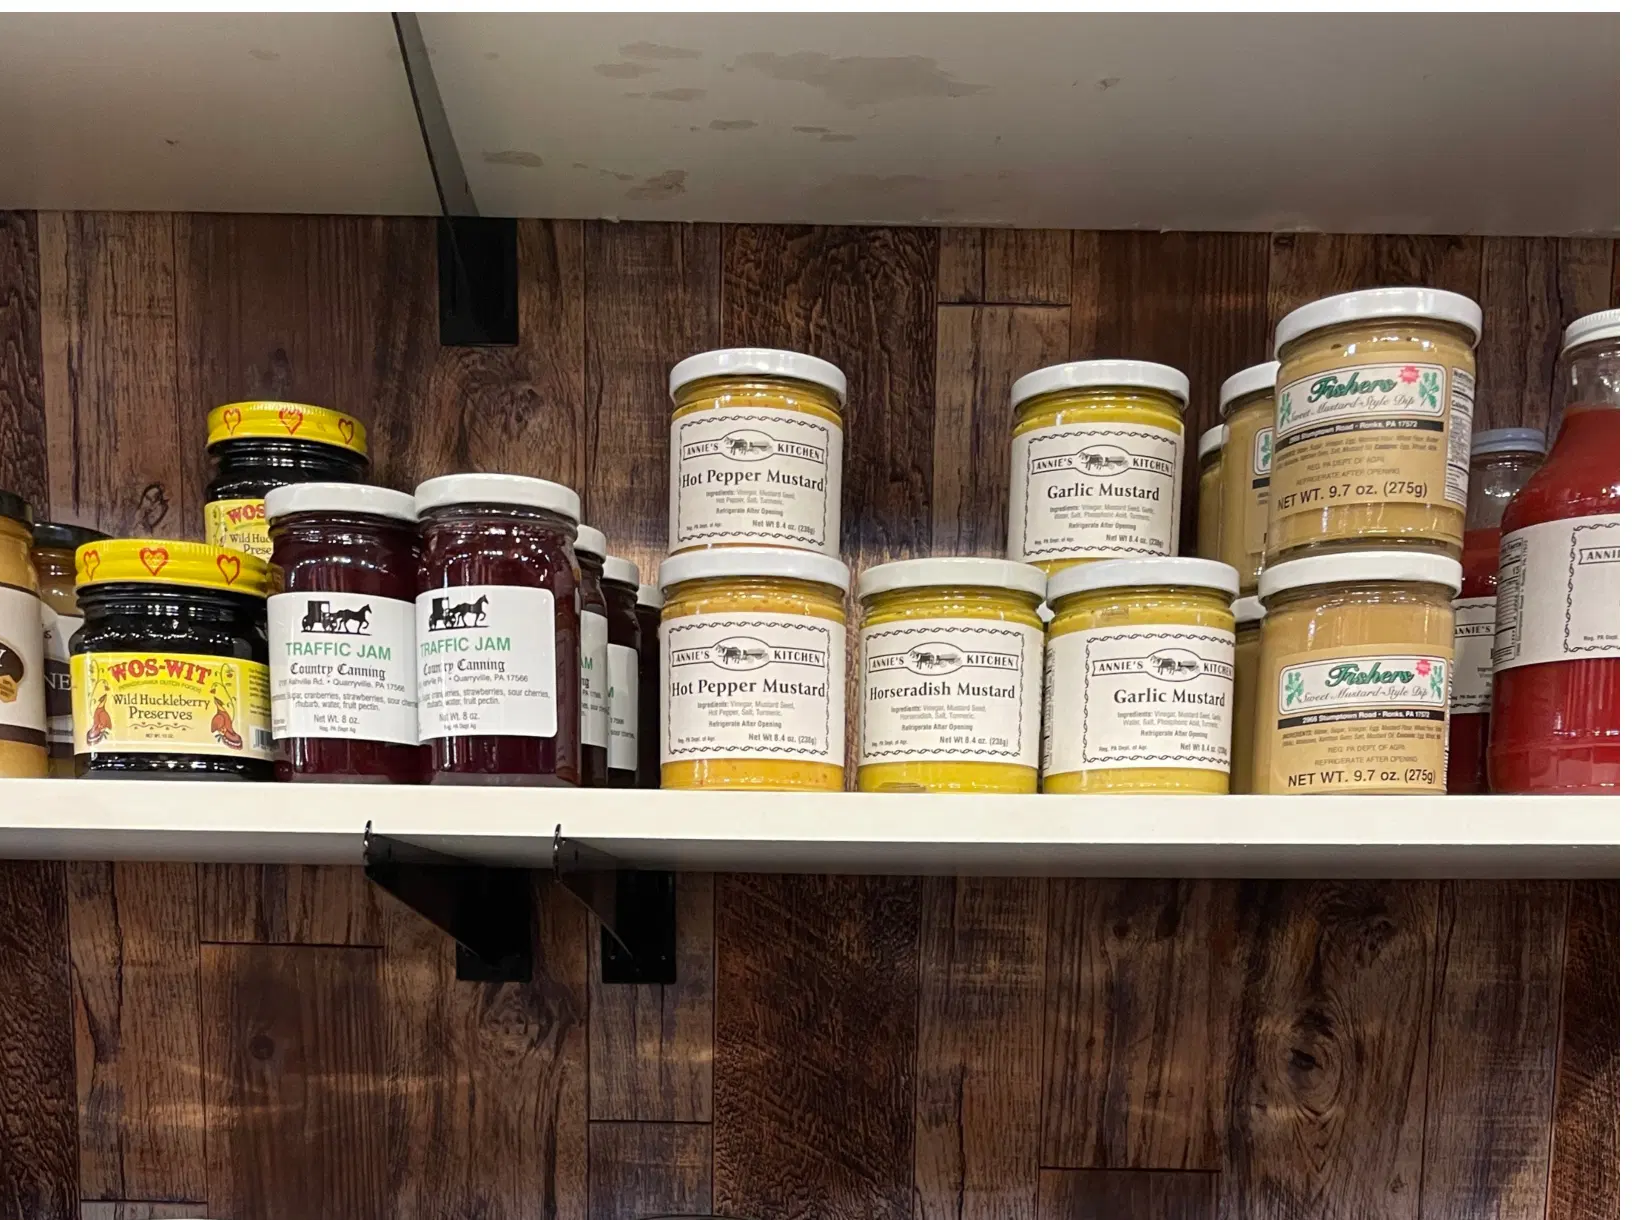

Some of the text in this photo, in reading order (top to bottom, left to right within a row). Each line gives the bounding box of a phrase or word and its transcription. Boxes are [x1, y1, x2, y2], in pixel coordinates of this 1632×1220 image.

[686, 442, 820, 459] ANNIE'S KITCHEN
[1036, 457, 1169, 472] ANNIE'S KITCHEN
[682, 469, 824, 491] Hot Pepper Mustard
[1047, 483, 1160, 501] Garlic Mustard
[1278, 481, 1428, 510] NET WT. 9.7 oz. (275g)
[1587, 550, 1620, 560] ANNI
[286, 642, 391, 660] TRAFFIC JAM
[420, 637, 511, 657] TRAFFIC JAM
[458, 658, 505, 672] Canning
[676, 650, 820, 663] ANNIE'S KITCHEN
[872, 655, 1013, 668] ANNIE'S KITCHEN
[108, 659, 212, 685] WOS-WIT
[290, 663, 386, 681] Country Canning
[1099, 661, 1233, 677] ANNIE'S KITCHEN
[672, 678, 825, 697] Hot Pepper Mustard
[870, 682, 1015, 700] Horseradish Mustard
[1412, 687, 1428, 698] Dip
[113, 694, 211, 710] Wild Huckleberry
[1114, 688, 1225, 707] Garlic Mustard
[129, 706, 192, 721] Preserves
[758, 721, 782, 729] Opening
[774, 734, 785, 742] 8.4
[1288, 768, 1436, 787] NET WT. 9.7 oz. (275g)
